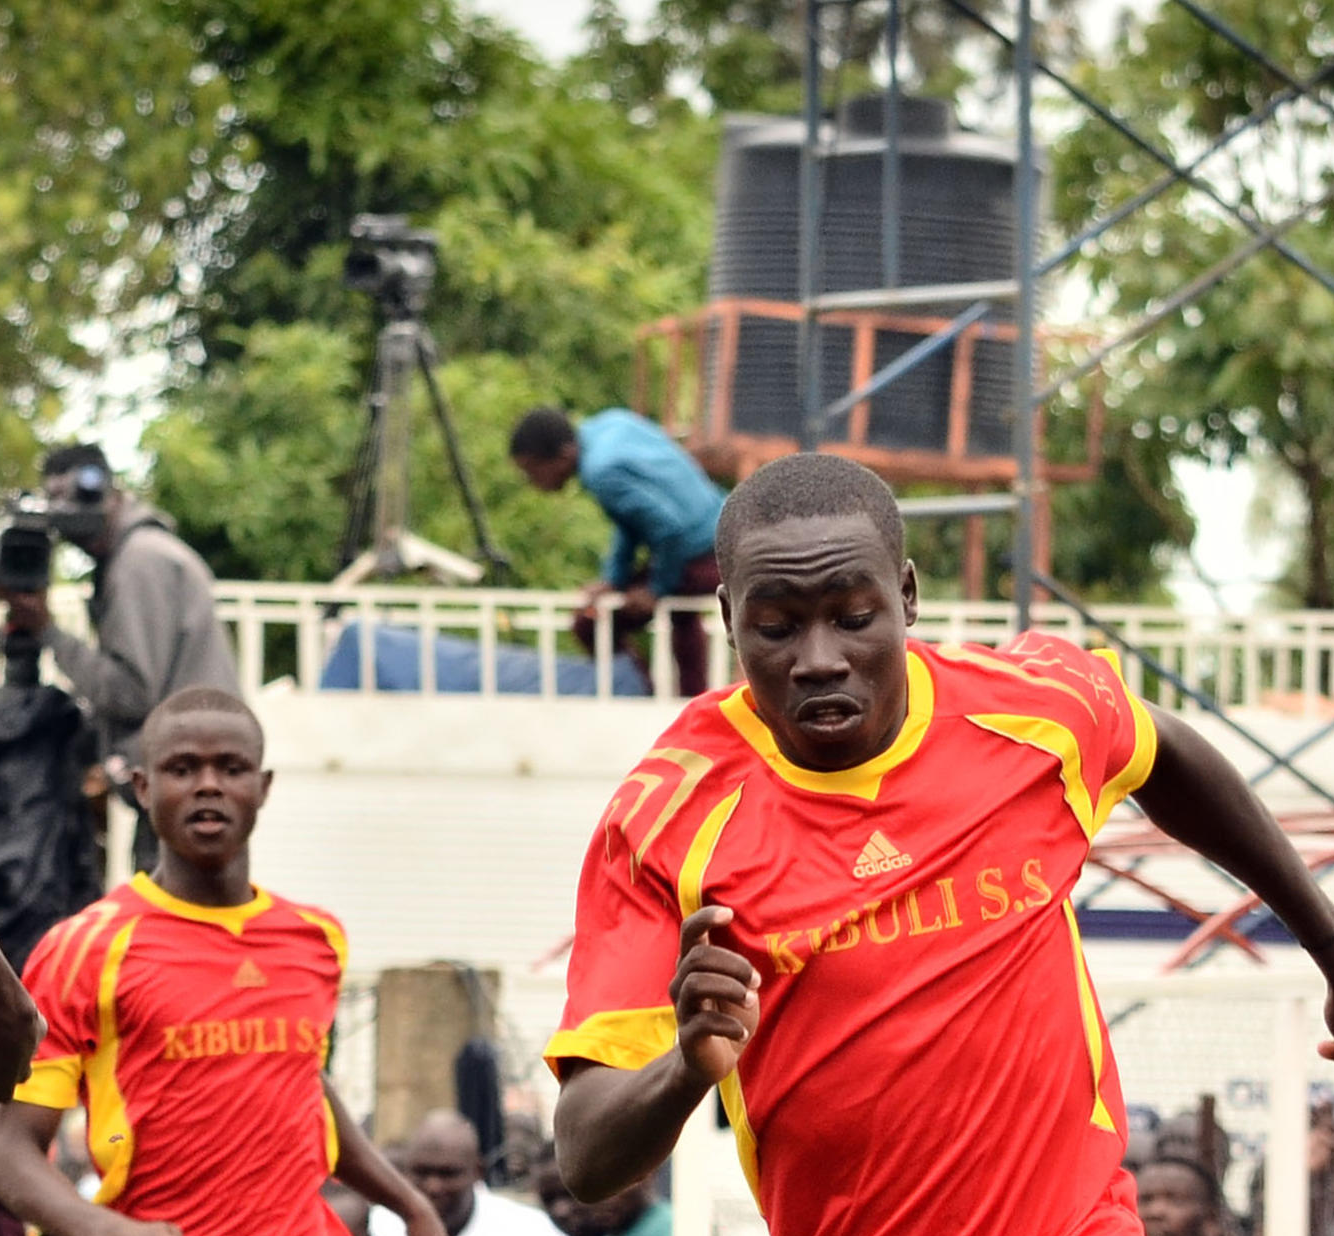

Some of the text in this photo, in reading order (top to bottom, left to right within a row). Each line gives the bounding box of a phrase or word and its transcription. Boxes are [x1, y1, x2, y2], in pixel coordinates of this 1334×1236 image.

[853, 854, 912, 877] adidas
[764, 877, 962, 975] KIBULI
[164, 1018, 287, 1059] KIBULI
